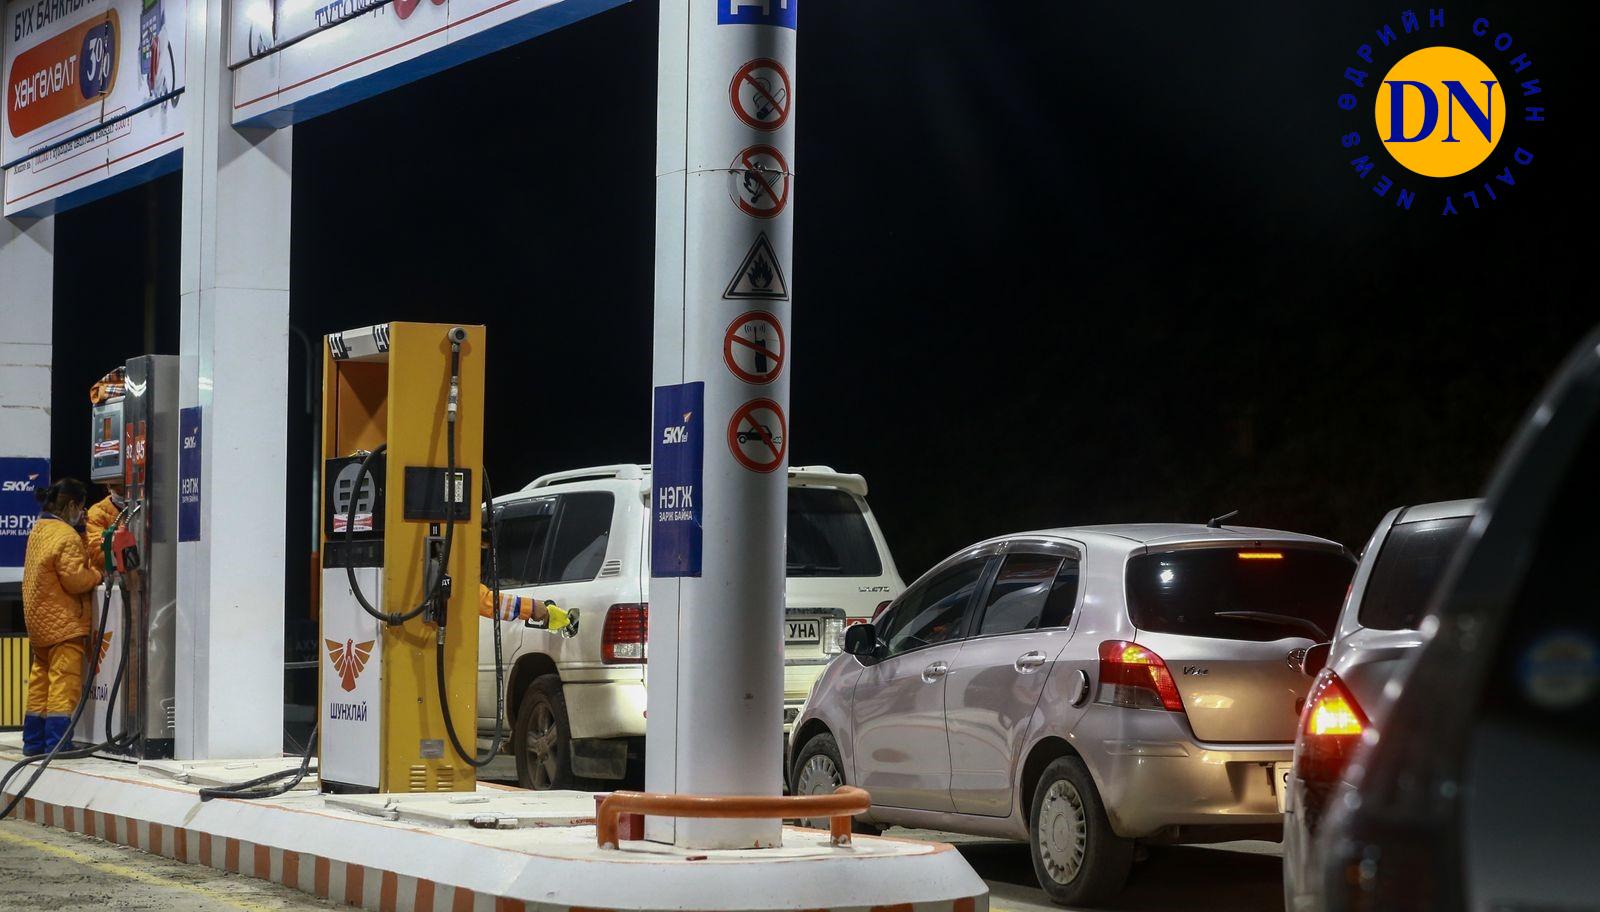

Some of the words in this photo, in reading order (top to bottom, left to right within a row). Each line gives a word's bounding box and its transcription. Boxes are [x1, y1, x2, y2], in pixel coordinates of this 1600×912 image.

[14, 54, 78, 112] ХӨНГӨЛӨЛТ
[87, 37, 110, 84] 3%
[659, 486, 693, 509] НЭГЖ
[674, 509, 693, 521] БАЙНА
[789, 623, 817, 639] УНА
[330, 700, 367, 721] ШУНХЛАЙ
